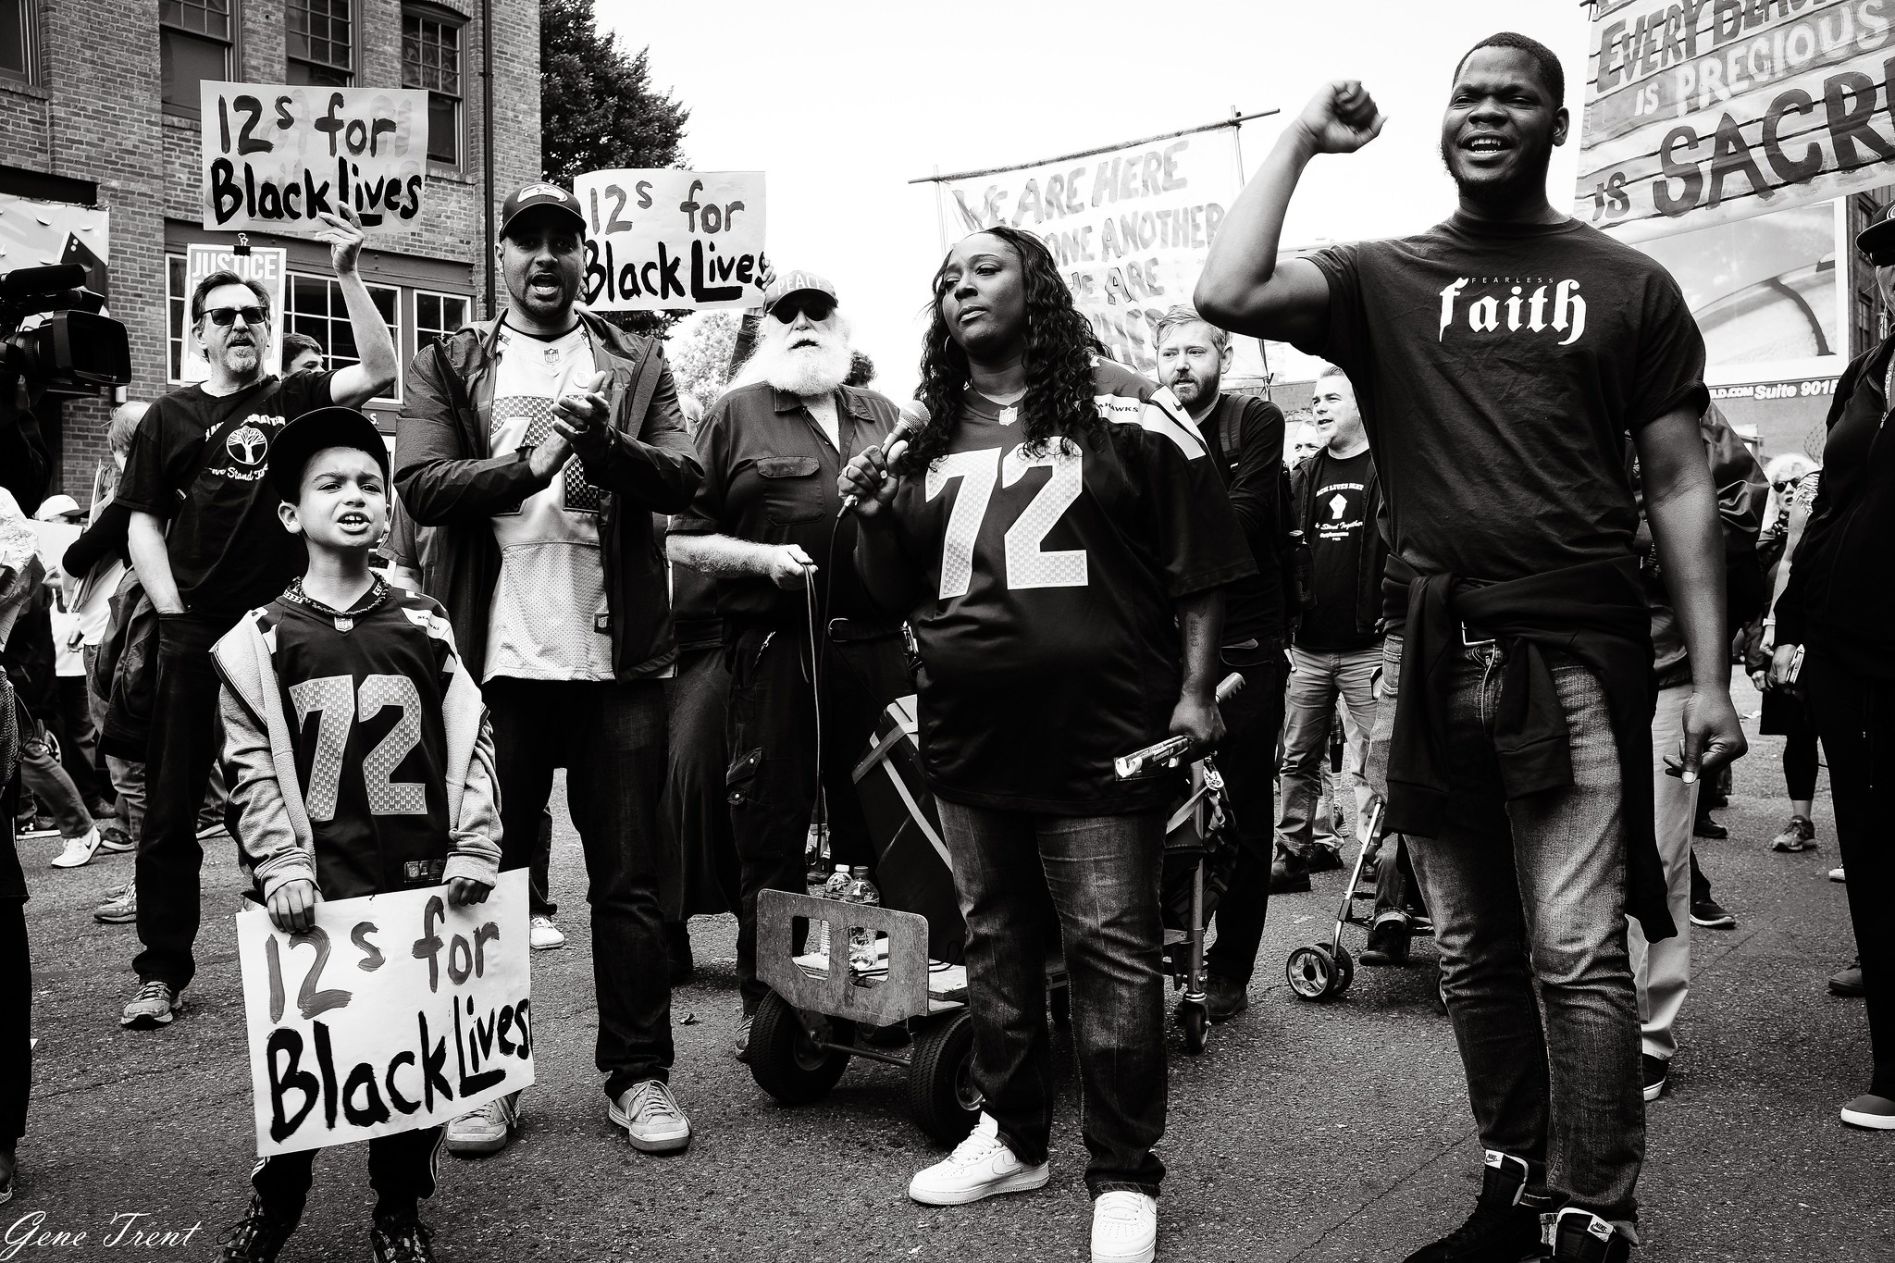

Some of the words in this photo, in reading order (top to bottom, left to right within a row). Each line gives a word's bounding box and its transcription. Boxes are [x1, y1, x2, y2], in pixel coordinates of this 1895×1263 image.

[1597, 0, 1703, 93] EVERY
[1634, 82, 1660, 117] IS
[1675, 1, 1891, 118] PRECIOUS
[314, 91, 397, 158] for
[211, 157, 334, 225] Black
[680, 179, 745, 234] for
[1012, 167, 1087, 228] ARE
[1091, 140, 1190, 208] HERE
[1592, 171, 1631, 221] IS
[192, 252, 278, 281] JUSTICE
[584, 239, 687, 306] Black
[1439, 276, 1587, 346] faith
[1754, 383, 1797, 400] Suite
[925, 436, 1089, 601] 72
[288, 674, 428, 822] 72
[411, 895, 500, 993] for
[266, 1010, 454, 1144] Black
[453, 994, 534, 1098] Lives
